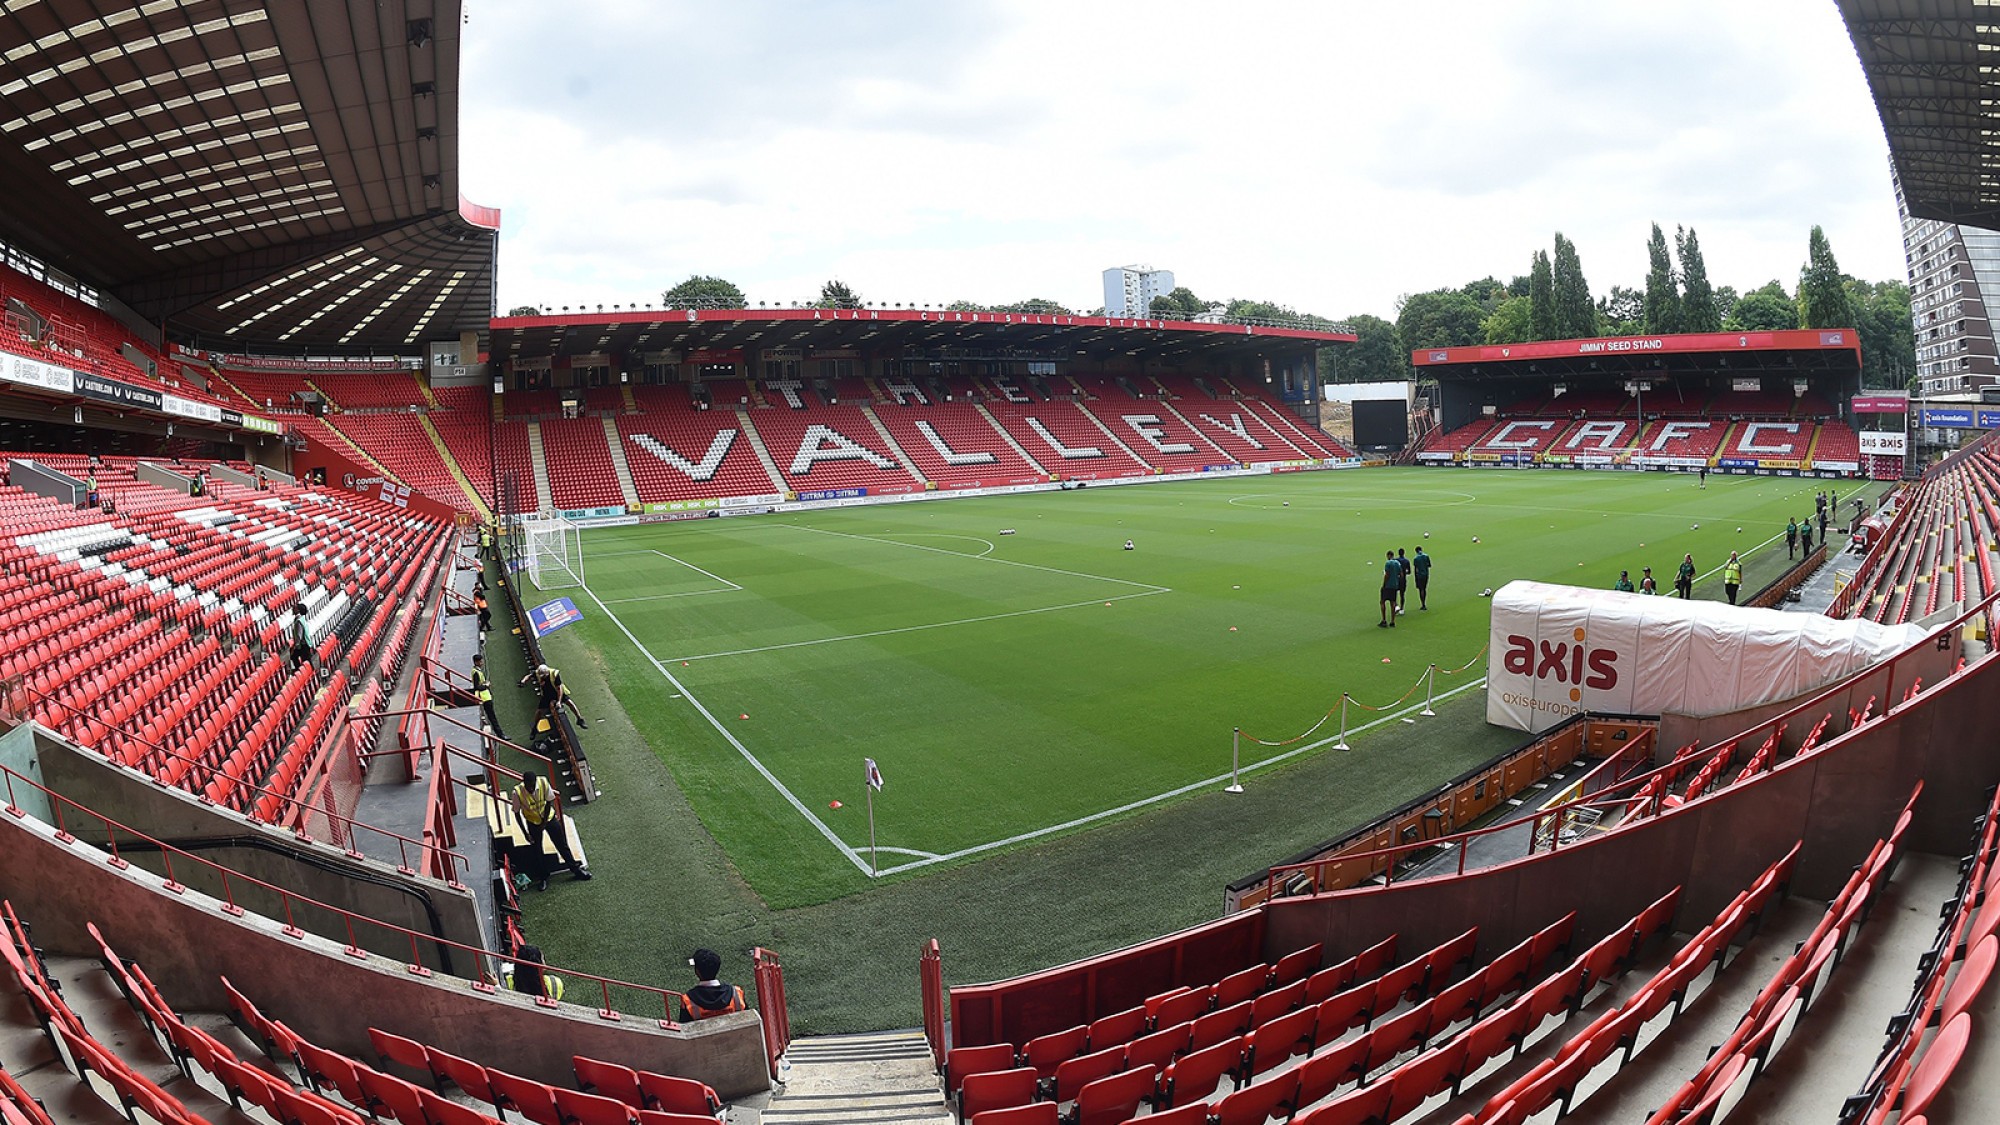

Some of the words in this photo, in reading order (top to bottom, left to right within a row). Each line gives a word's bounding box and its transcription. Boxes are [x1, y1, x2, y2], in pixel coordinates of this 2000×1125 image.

[814, 311, 879, 320] ALAN
[920, 311, 1073, 325] CURBISHLEY
[1105, 318, 1165, 330] STAND
[1579, 342, 1606, 353] JIMMY
[1607, 341, 1631, 351] SEED
[1633, 339, 1662, 350] STAND
[765, 378, 1035, 409] THE
[1941, 413, 1969, 422] foundation
[1486, 420, 1800, 454] CAFC
[1861, 436, 1876, 448] axis
[1879, 434, 1903, 450] axis
[629, 413, 1267, 481] VALLEY
[356, 477, 385, 485] COVERED
[1504, 627, 1618, 702] axis
[1502, 692, 1590, 717] axiseurope
